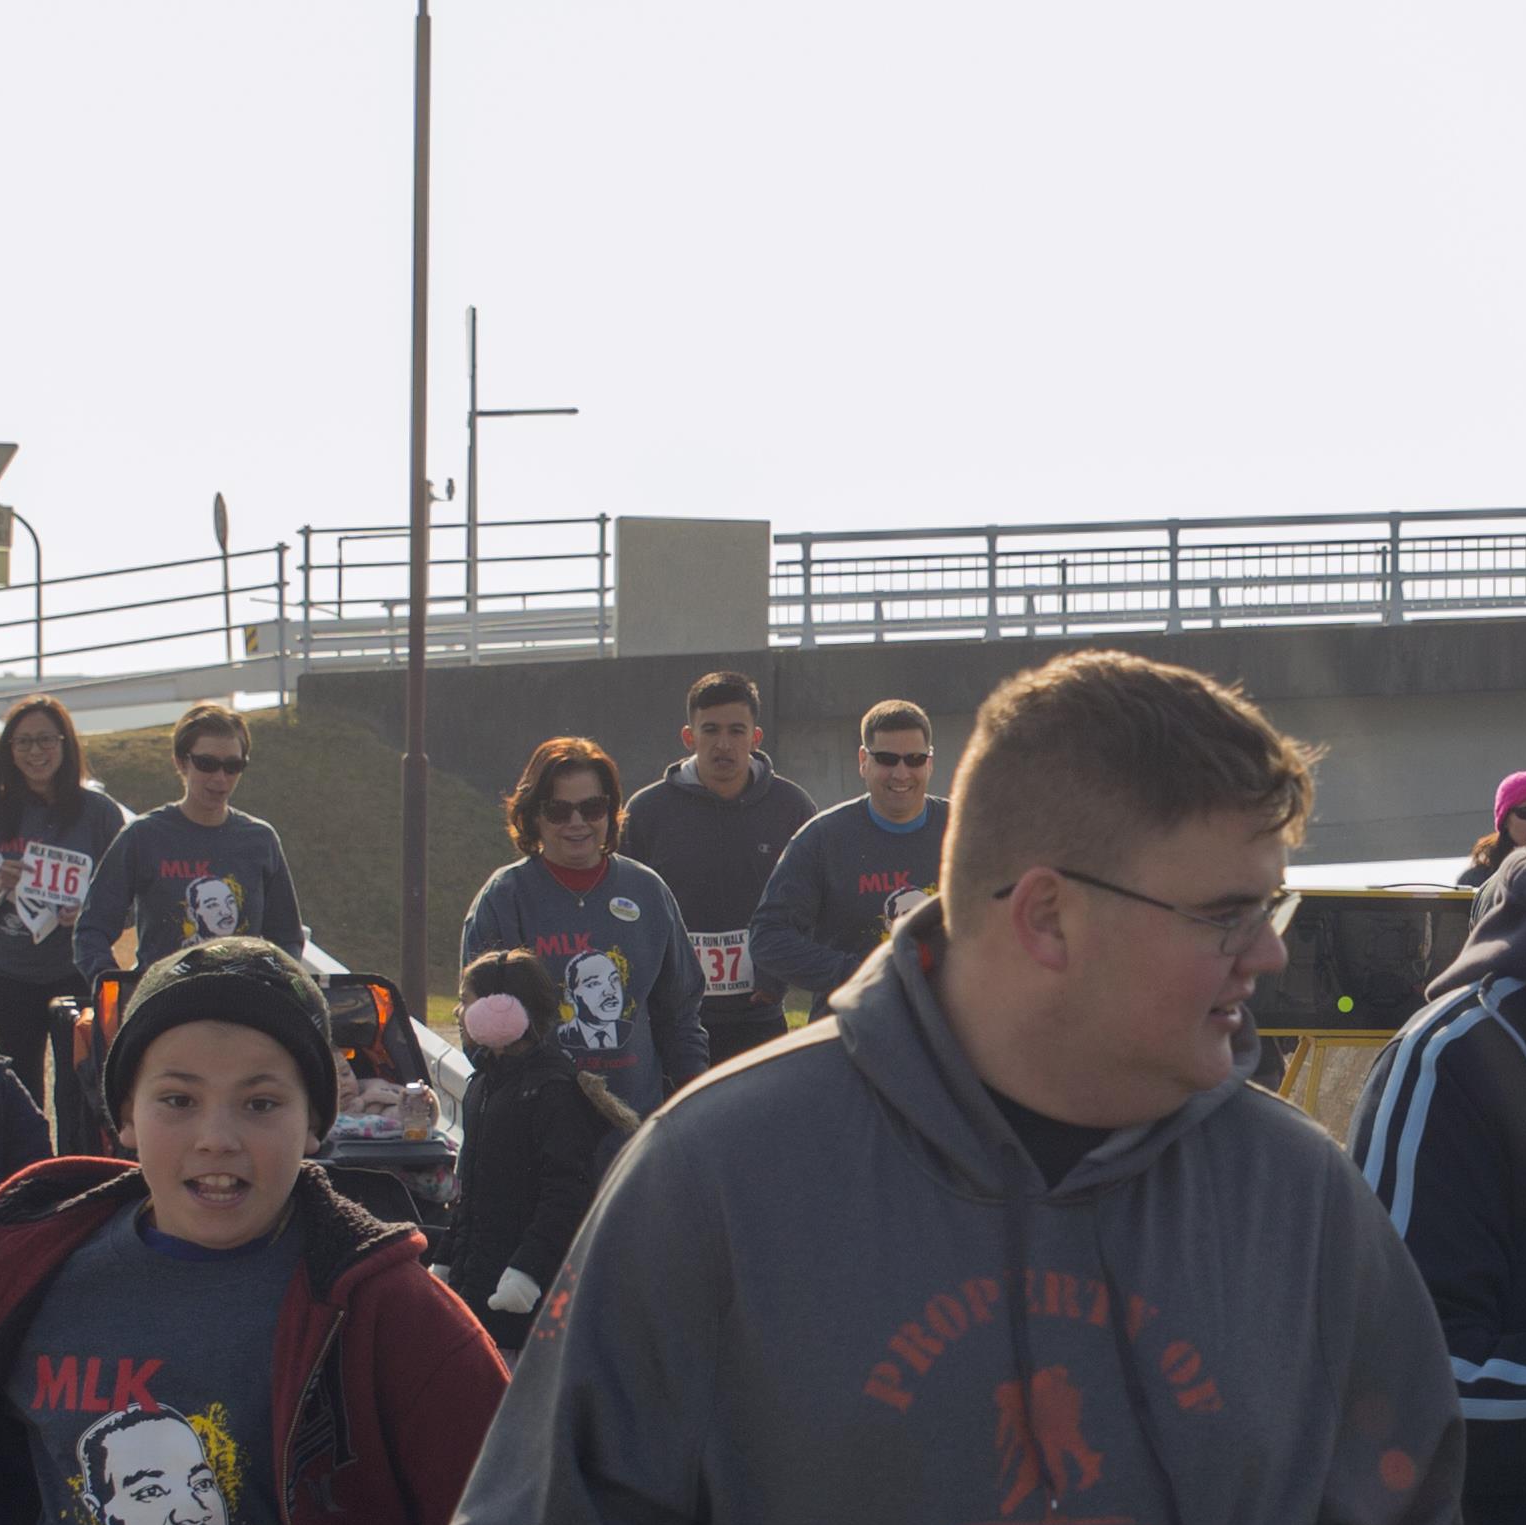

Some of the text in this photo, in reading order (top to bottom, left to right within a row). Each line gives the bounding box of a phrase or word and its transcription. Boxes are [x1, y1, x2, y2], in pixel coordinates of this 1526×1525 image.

[30, 845, 87, 866] MLK RUN/WALK
[31, 859, 81, 895] 116
[160, 859, 213, 879] MLK
[858, 870, 912, 896] MLK
[536, 931, 594, 959] MLK
[702, 933, 745, 946] RUN/WALK
[712, 982, 726, 991] TEEN
[31, 1355, 164, 1413] MLK
[1159, 1340, 1224, 1415] OF
